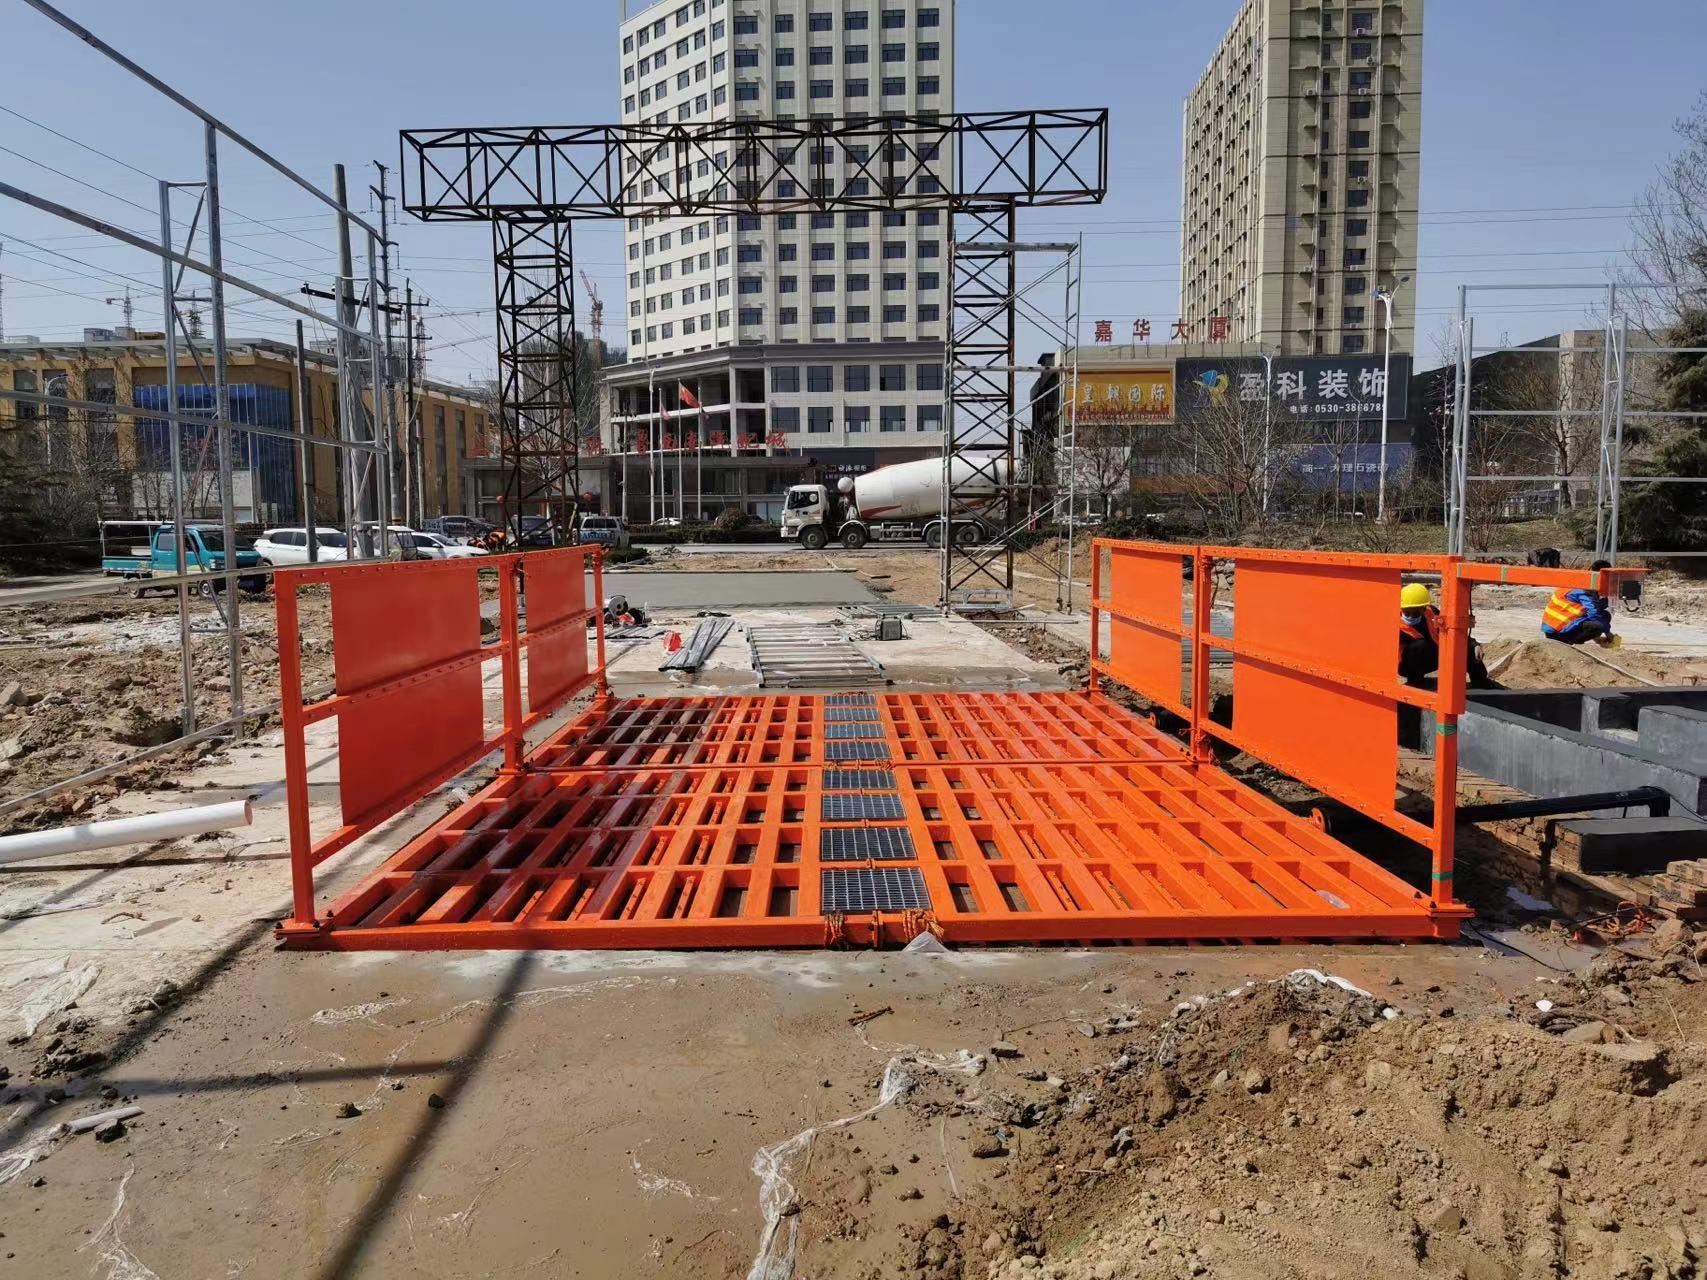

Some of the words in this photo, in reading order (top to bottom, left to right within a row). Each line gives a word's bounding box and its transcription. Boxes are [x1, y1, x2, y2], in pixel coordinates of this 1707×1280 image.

[1094, 317, 1228, 342] 嘉华大厦
[1240, 368, 1389, 401] 盈科装饰
